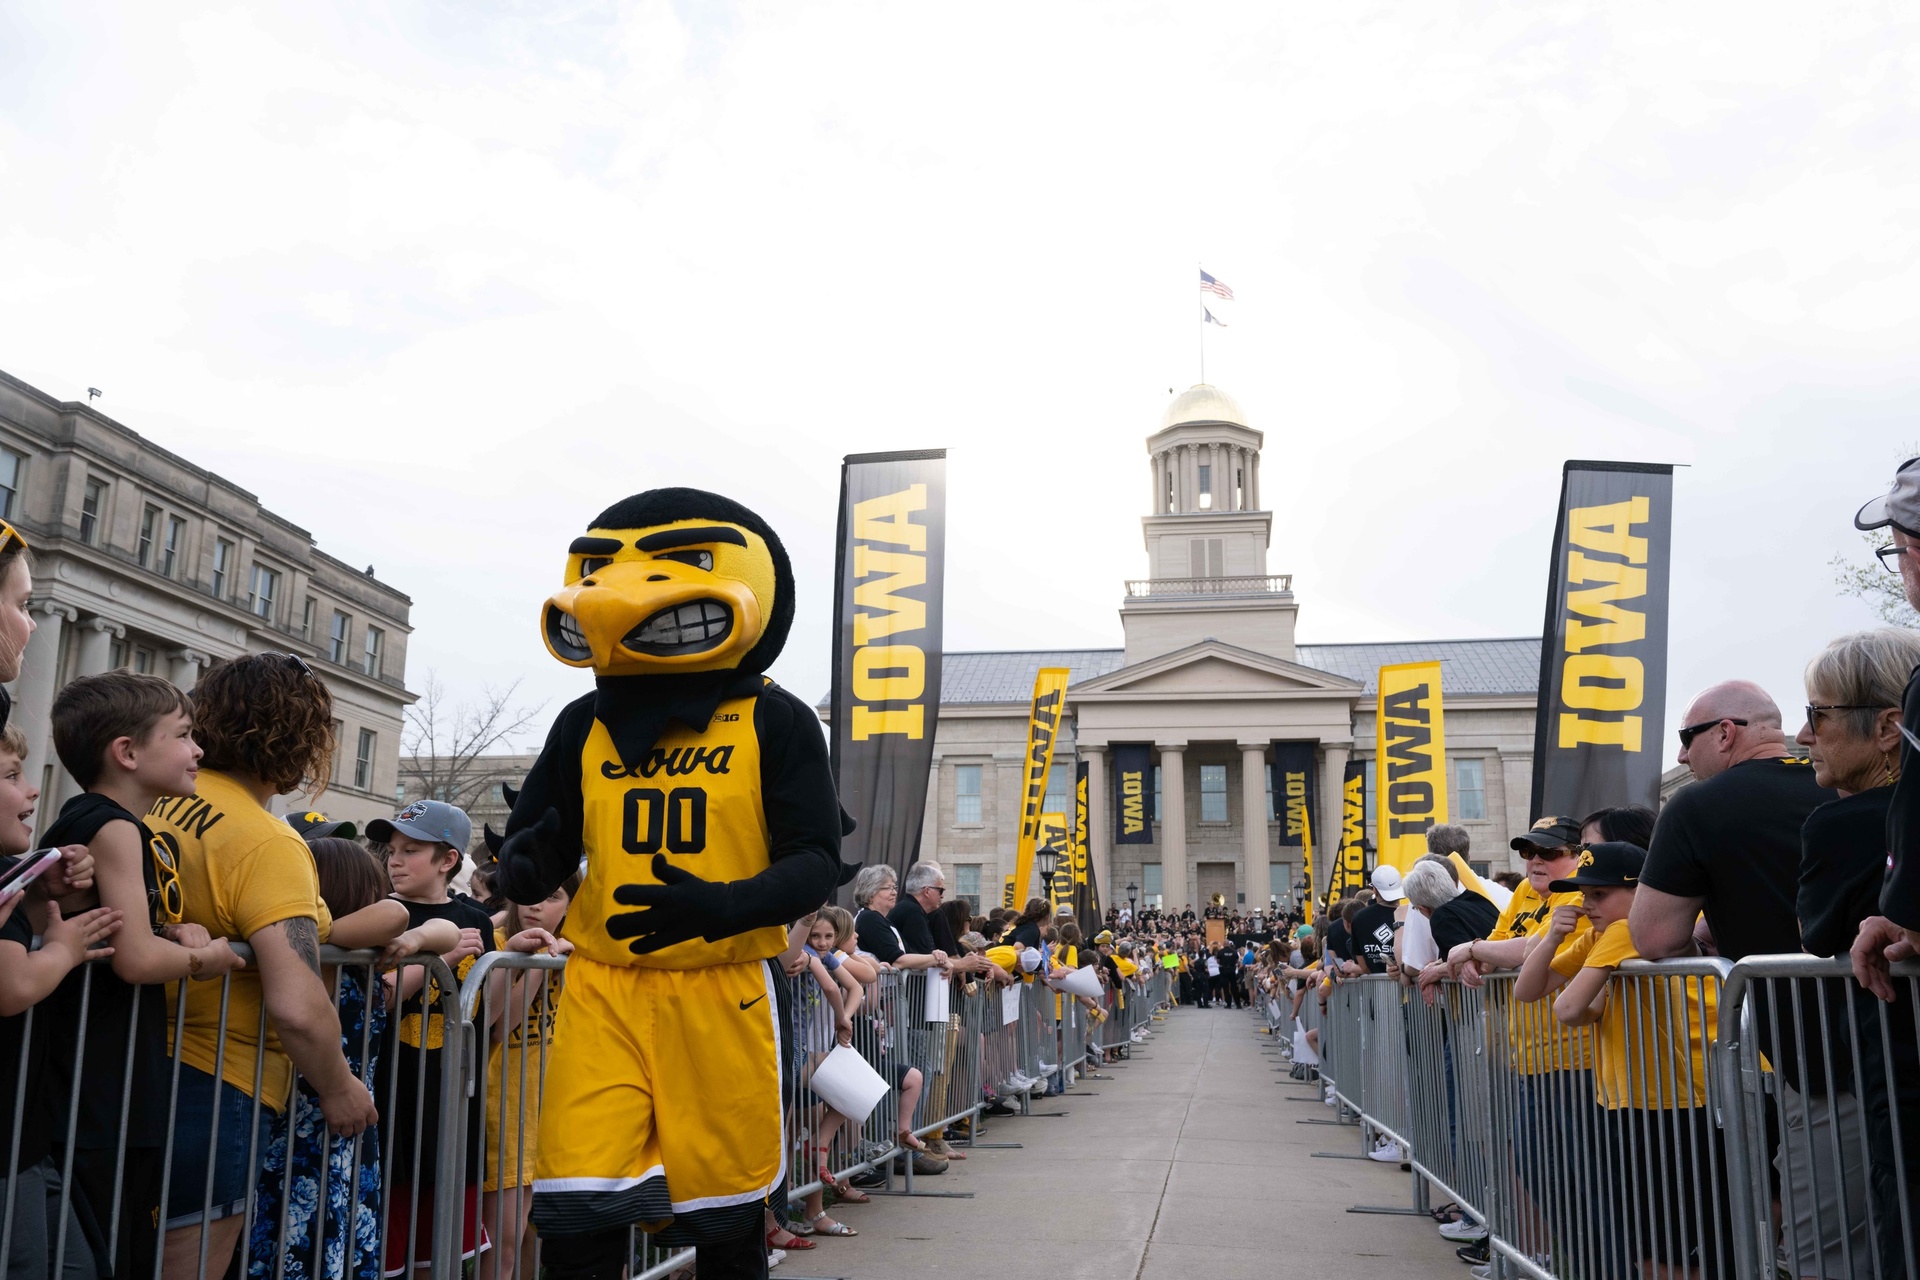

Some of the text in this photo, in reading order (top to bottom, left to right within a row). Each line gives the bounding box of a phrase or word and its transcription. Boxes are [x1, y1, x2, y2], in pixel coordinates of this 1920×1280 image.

[852, 483, 927, 741] IOWA
[1558, 496, 1650, 752] IOWA
[1122, 771, 1144, 835] IOWA
[1285, 771, 1305, 837] IOWA
[1384, 683, 1434, 839] IOWA
[147, 793, 226, 840] RTIN
[622, 787, 707, 854] 00
[1075, 775, 1087, 886] IOWA
[1343, 774, 1364, 888] IOWA
[1004, 882, 1015, 908] WA
